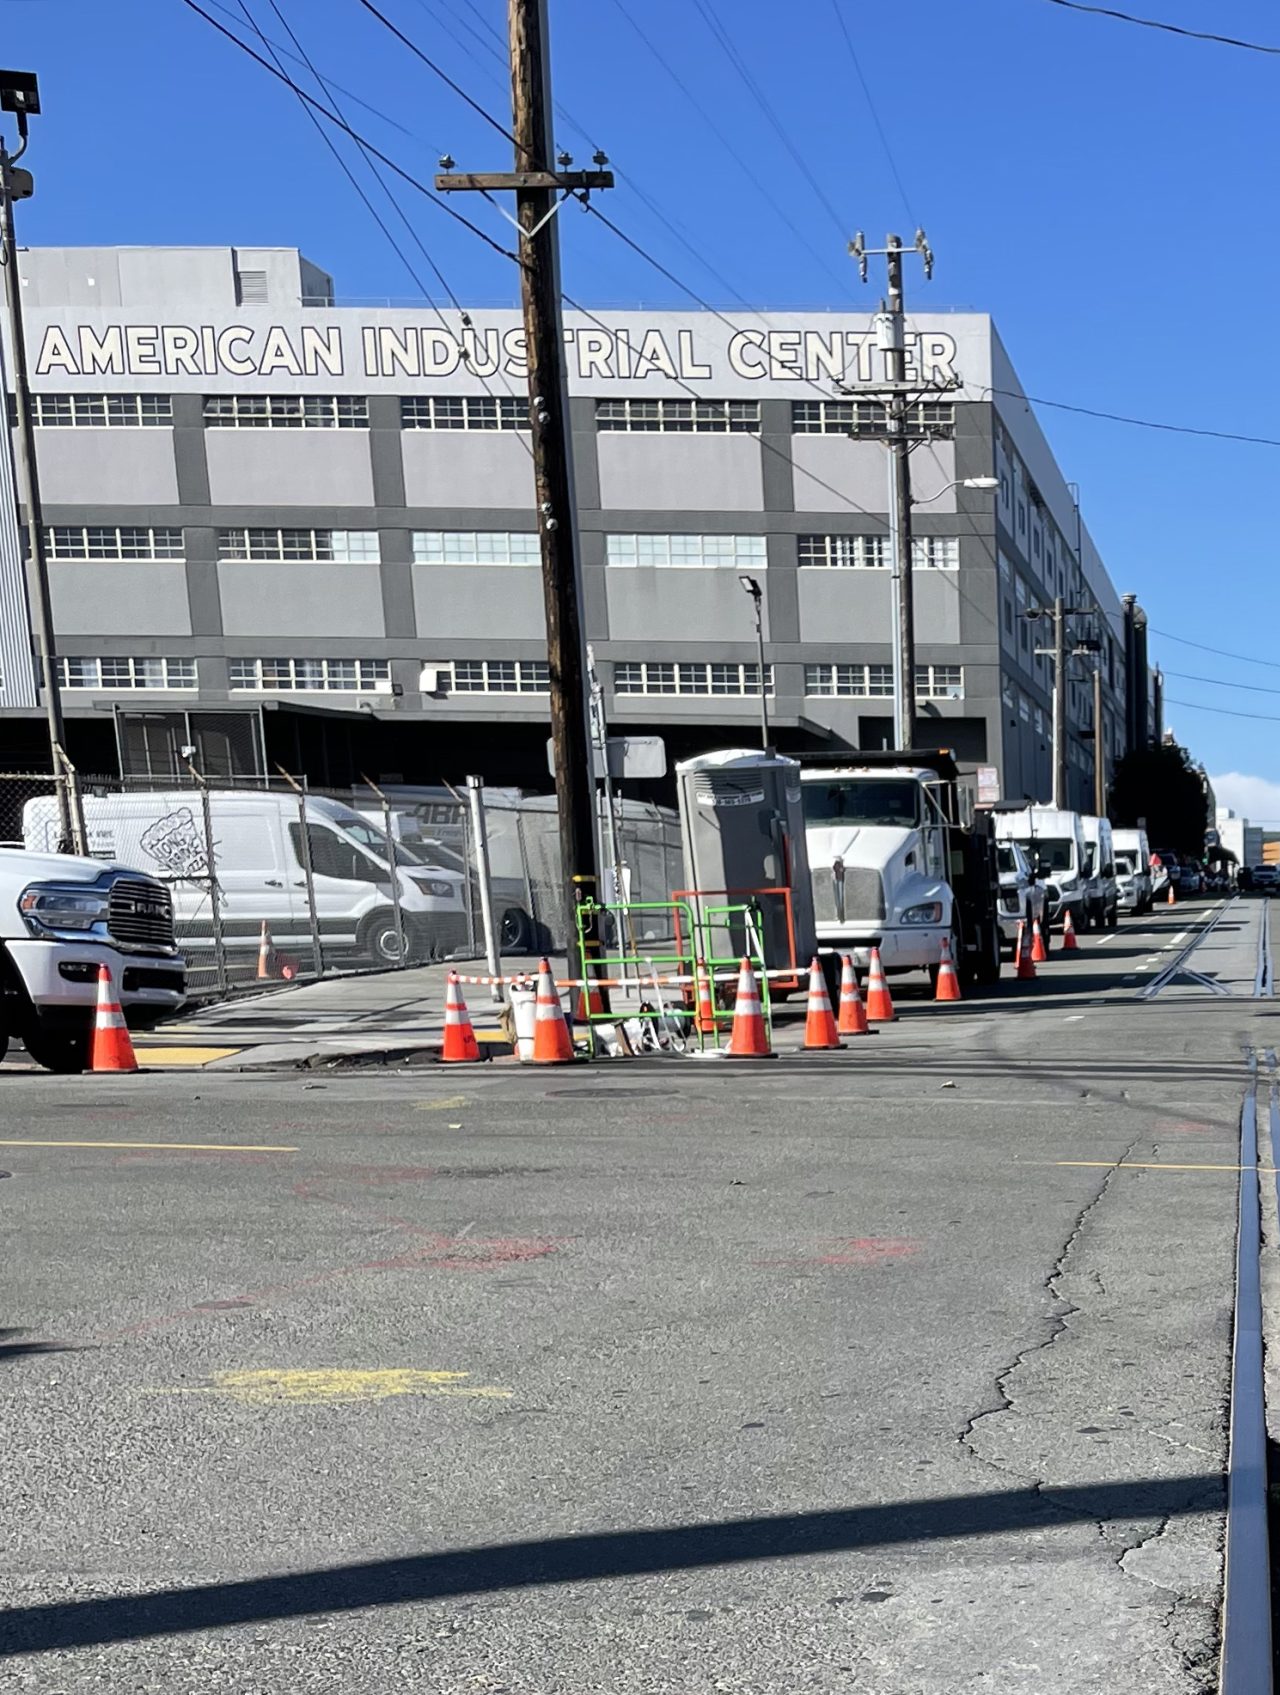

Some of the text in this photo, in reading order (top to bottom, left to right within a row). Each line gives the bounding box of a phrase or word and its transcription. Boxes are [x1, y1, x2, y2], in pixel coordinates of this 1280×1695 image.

[35, 325, 957, 382] AMERICAN INDUSRIAL CENTER
